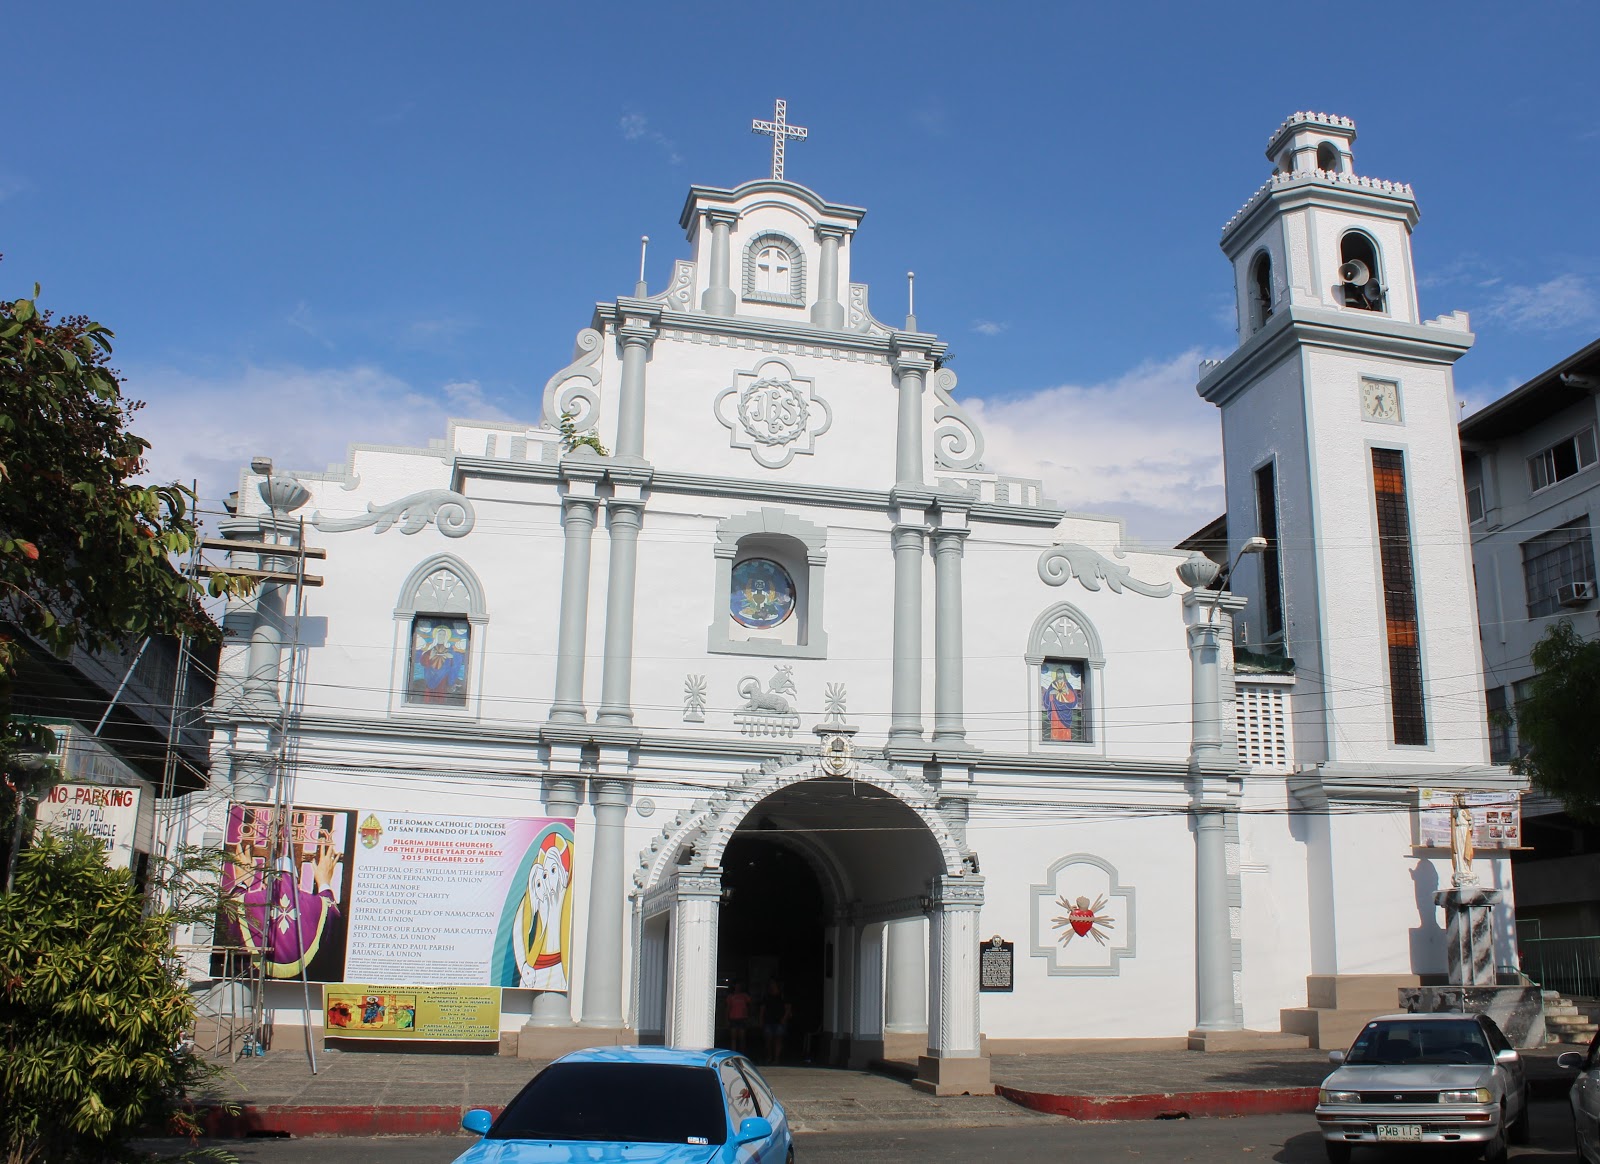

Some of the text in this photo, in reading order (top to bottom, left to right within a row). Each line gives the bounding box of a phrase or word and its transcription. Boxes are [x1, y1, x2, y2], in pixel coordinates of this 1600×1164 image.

[48, 786, 133, 807] NO PARKING
[67, 808, 81, 821] PUB
[90, 809, 105, 822] PUJ
[435, 820, 473, 828] CATHOLIC
[88, 823, 117, 837] VEHICLE
[416, 827, 456, 835] FERNANDO
[424, 855, 462, 863] DECEMBER
[359, 865, 402, 873] CATHEDRAL
[357, 882, 389, 890] BASILICA
